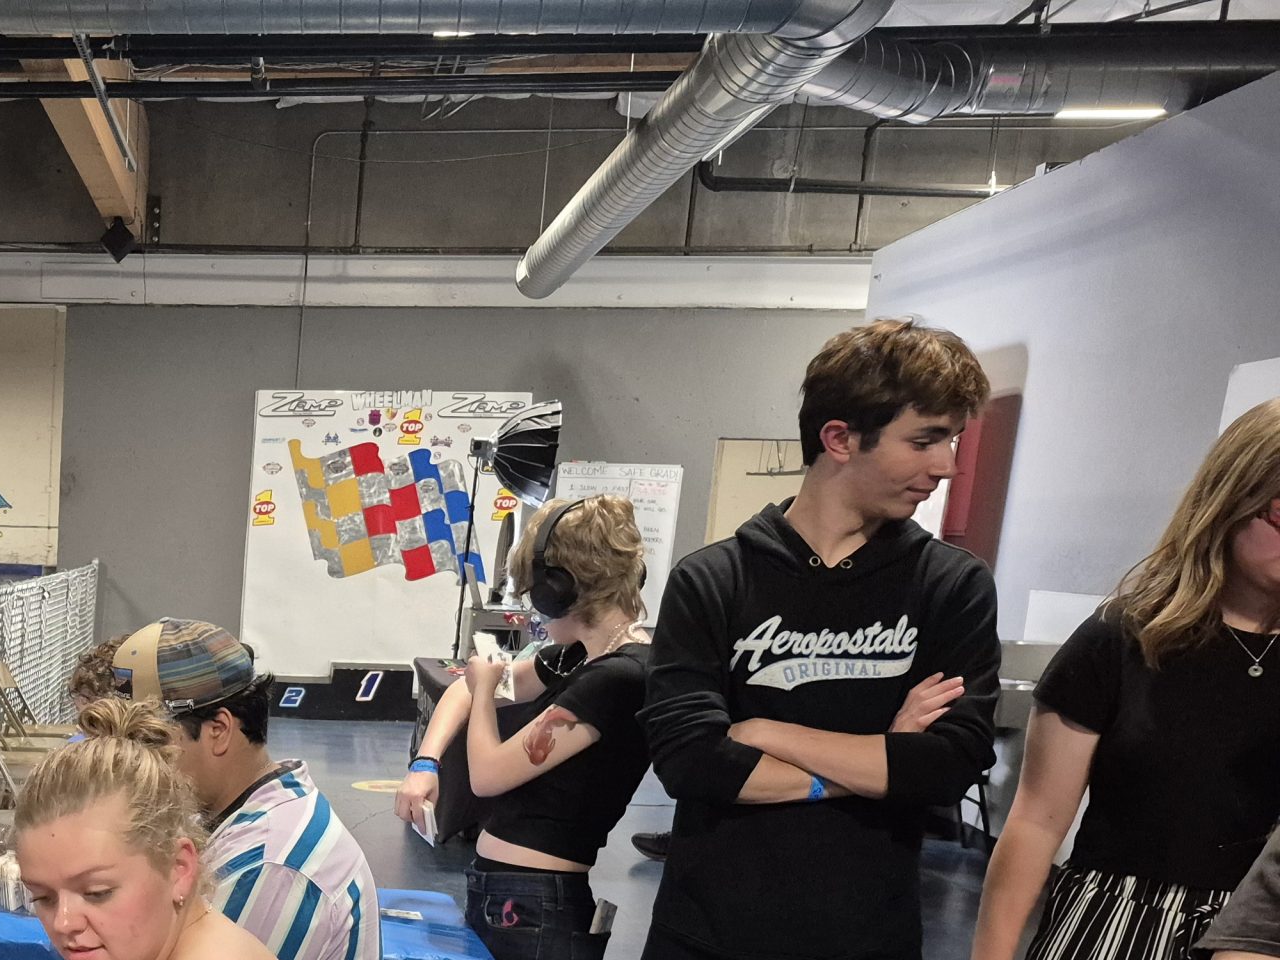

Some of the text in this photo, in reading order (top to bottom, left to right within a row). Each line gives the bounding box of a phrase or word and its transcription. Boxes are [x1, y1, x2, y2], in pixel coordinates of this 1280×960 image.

[351, 389, 433, 411] WHEELMAN
[402, 422, 423, 432] TOP
[255, 503, 275, 513] TOP
[495, 499, 518, 508] TOP
[729, 614, 918, 672] Aeropostale
[783, 662, 882, 684] ORIGINAL
[355, 671, 384, 701] 1
[279, 687, 306, 707] 2
